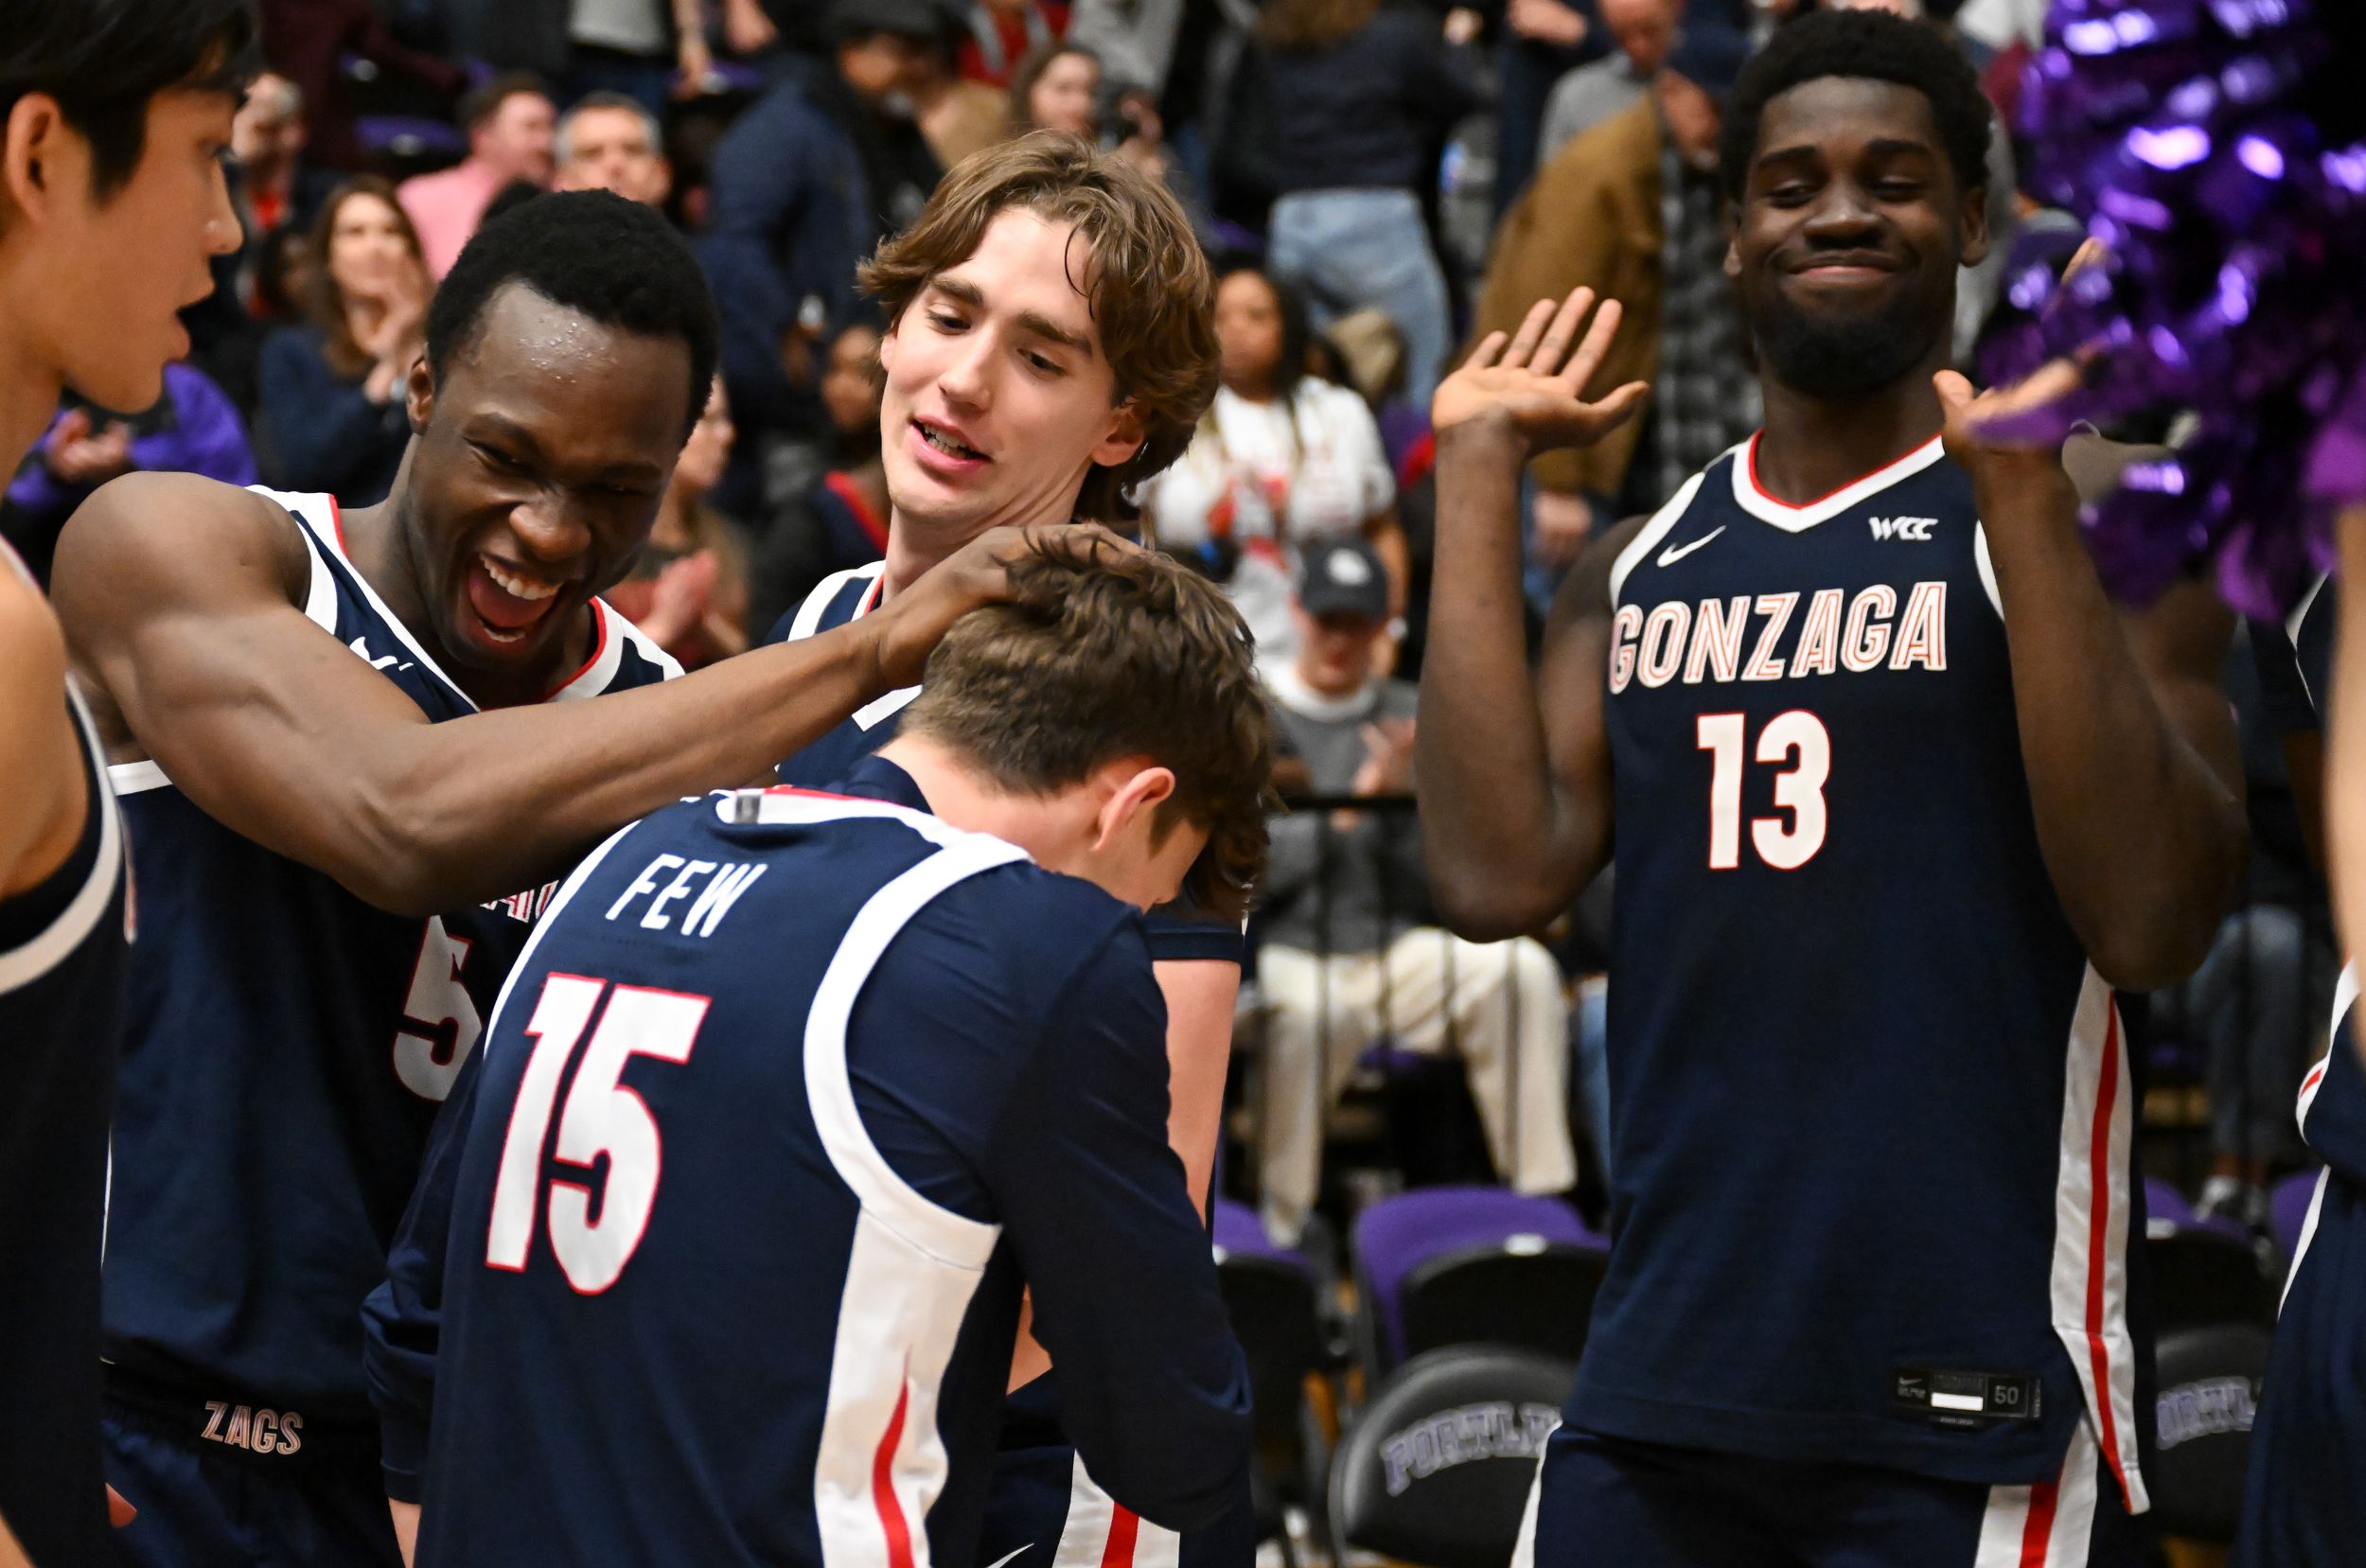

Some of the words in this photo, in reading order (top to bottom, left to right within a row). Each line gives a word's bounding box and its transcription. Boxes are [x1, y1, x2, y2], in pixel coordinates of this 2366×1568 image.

[1868, 515, 1939, 541] WCC
[1609, 581, 1948, 695] GONZAGA
[1696, 707, 1831, 871] 13
[605, 853, 768, 938] FEW
[390, 914, 484, 1104] 5
[485, 971, 713, 1296] 15
[201, 1401, 304, 1455] ZAGS
[1994, 1384, 2020, 1405] 50
[1379, 1401, 1563, 1498] PORTLA
